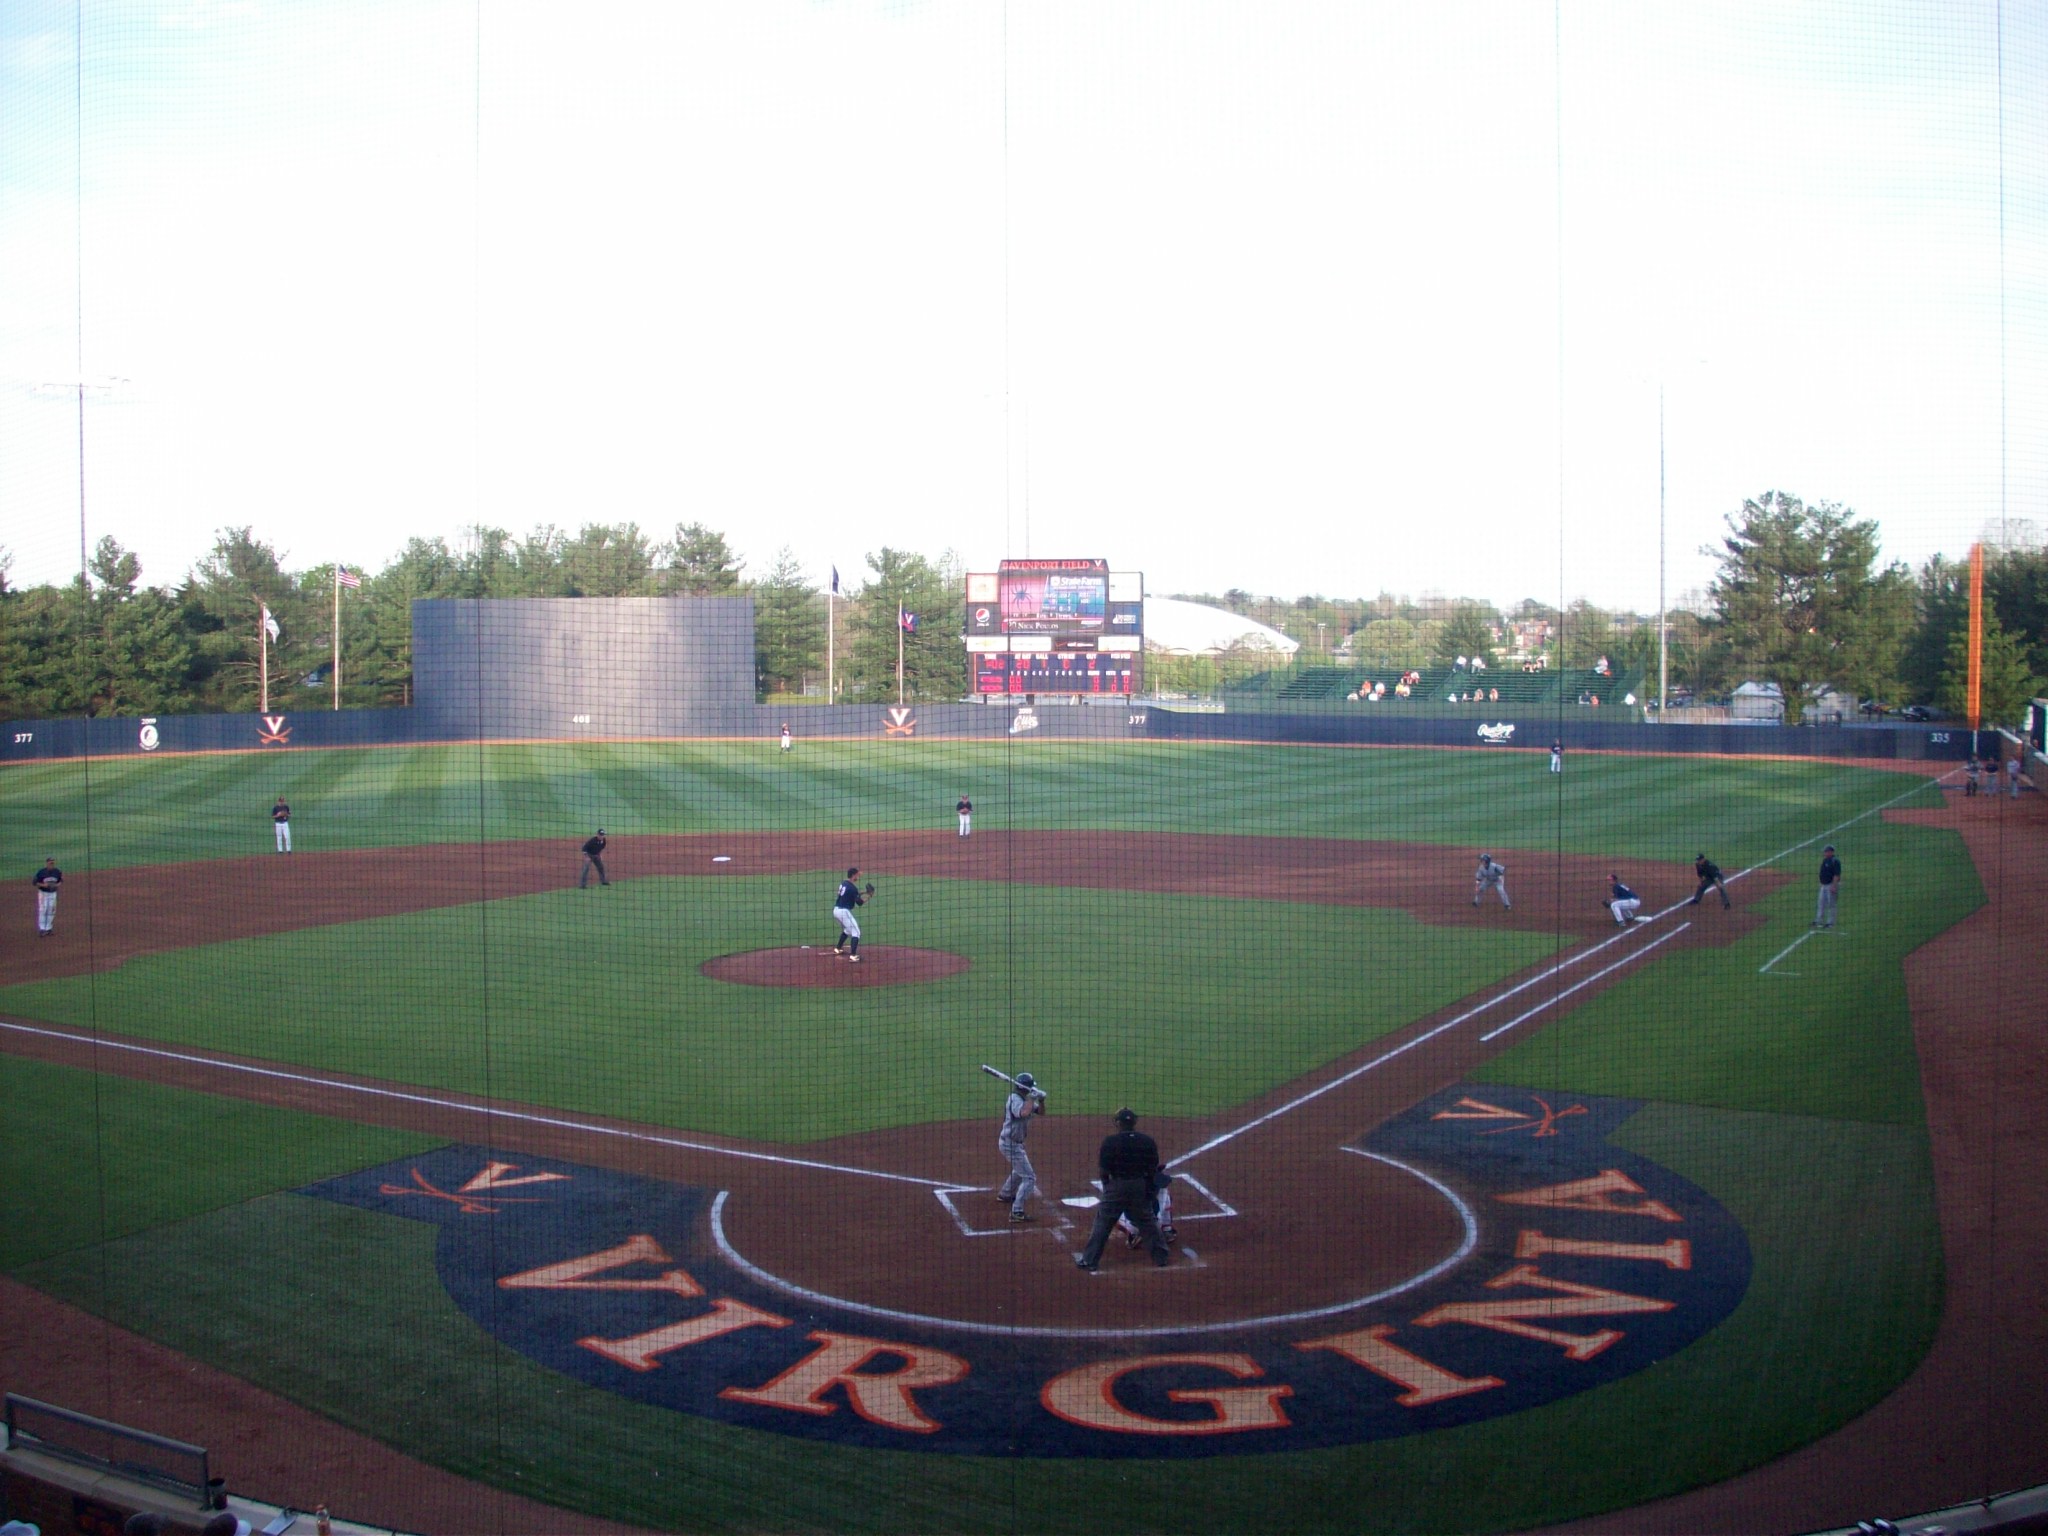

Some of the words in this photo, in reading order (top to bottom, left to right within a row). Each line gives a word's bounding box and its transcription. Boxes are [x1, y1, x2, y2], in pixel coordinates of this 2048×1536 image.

[1002, 560, 1058, 570] DAVENPORT
[1062, 560, 1090, 570] FIELD
[1061, 577, 1080, 586] State
[1081, 577, 1102, 586] Farm
[888, 708, 911, 726] V
[1128, 716, 1146, 725] 377
[262, 716, 285, 735] V
[14, 733, 33, 743] 377
[1931, 733, 1950, 743] 335
[497, 1169, 1692, 1436] VIRGINIA
